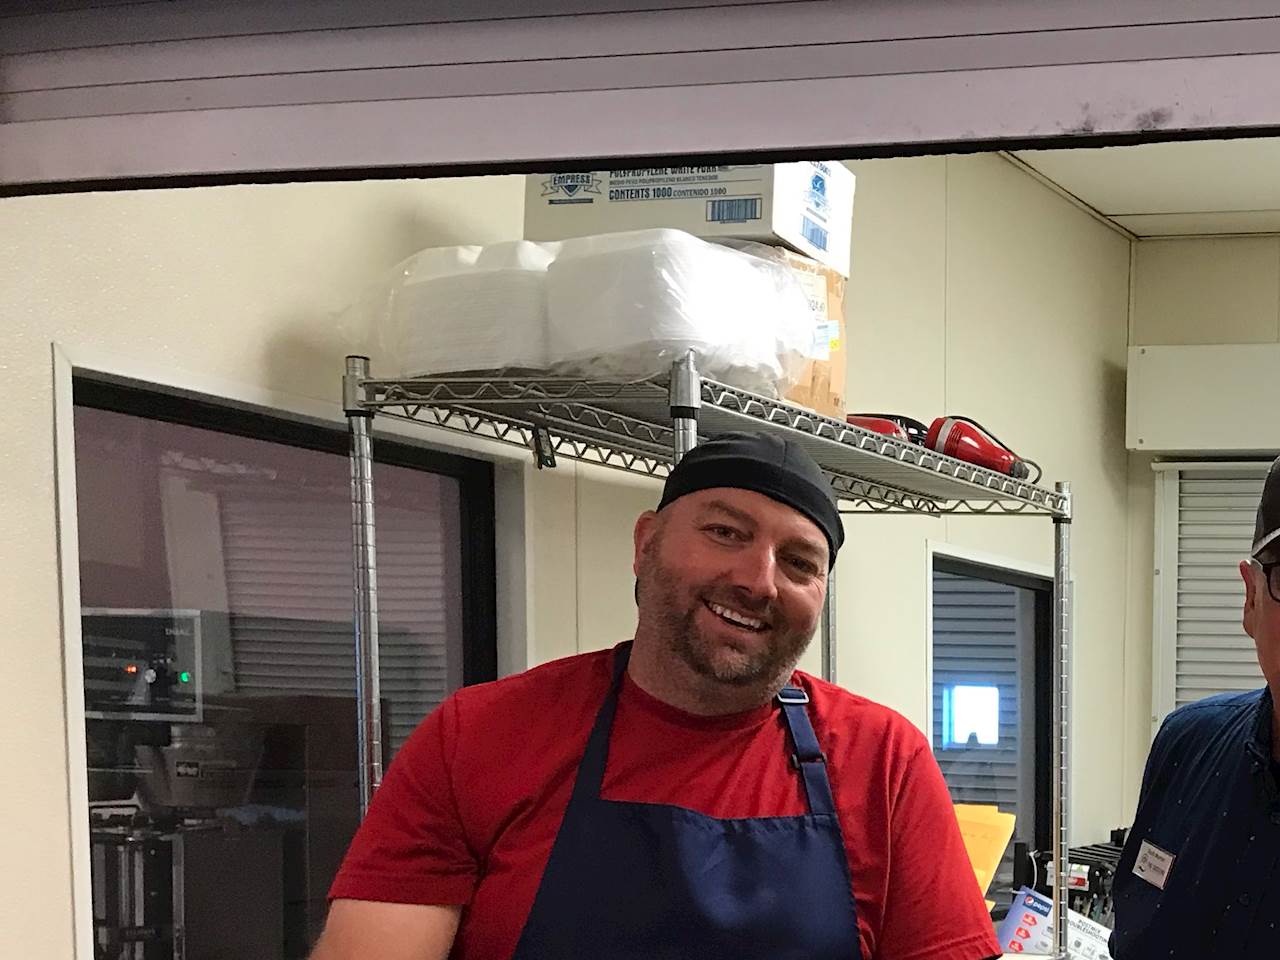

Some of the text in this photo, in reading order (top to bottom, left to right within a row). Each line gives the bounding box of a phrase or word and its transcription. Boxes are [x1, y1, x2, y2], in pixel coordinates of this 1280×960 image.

[553, 174, 590, 185] EMPRESS
[609, 187, 726, 200] CONTENTS 1000 CONTENIDO 1000
[1033, 901, 1050, 912] pepsi
